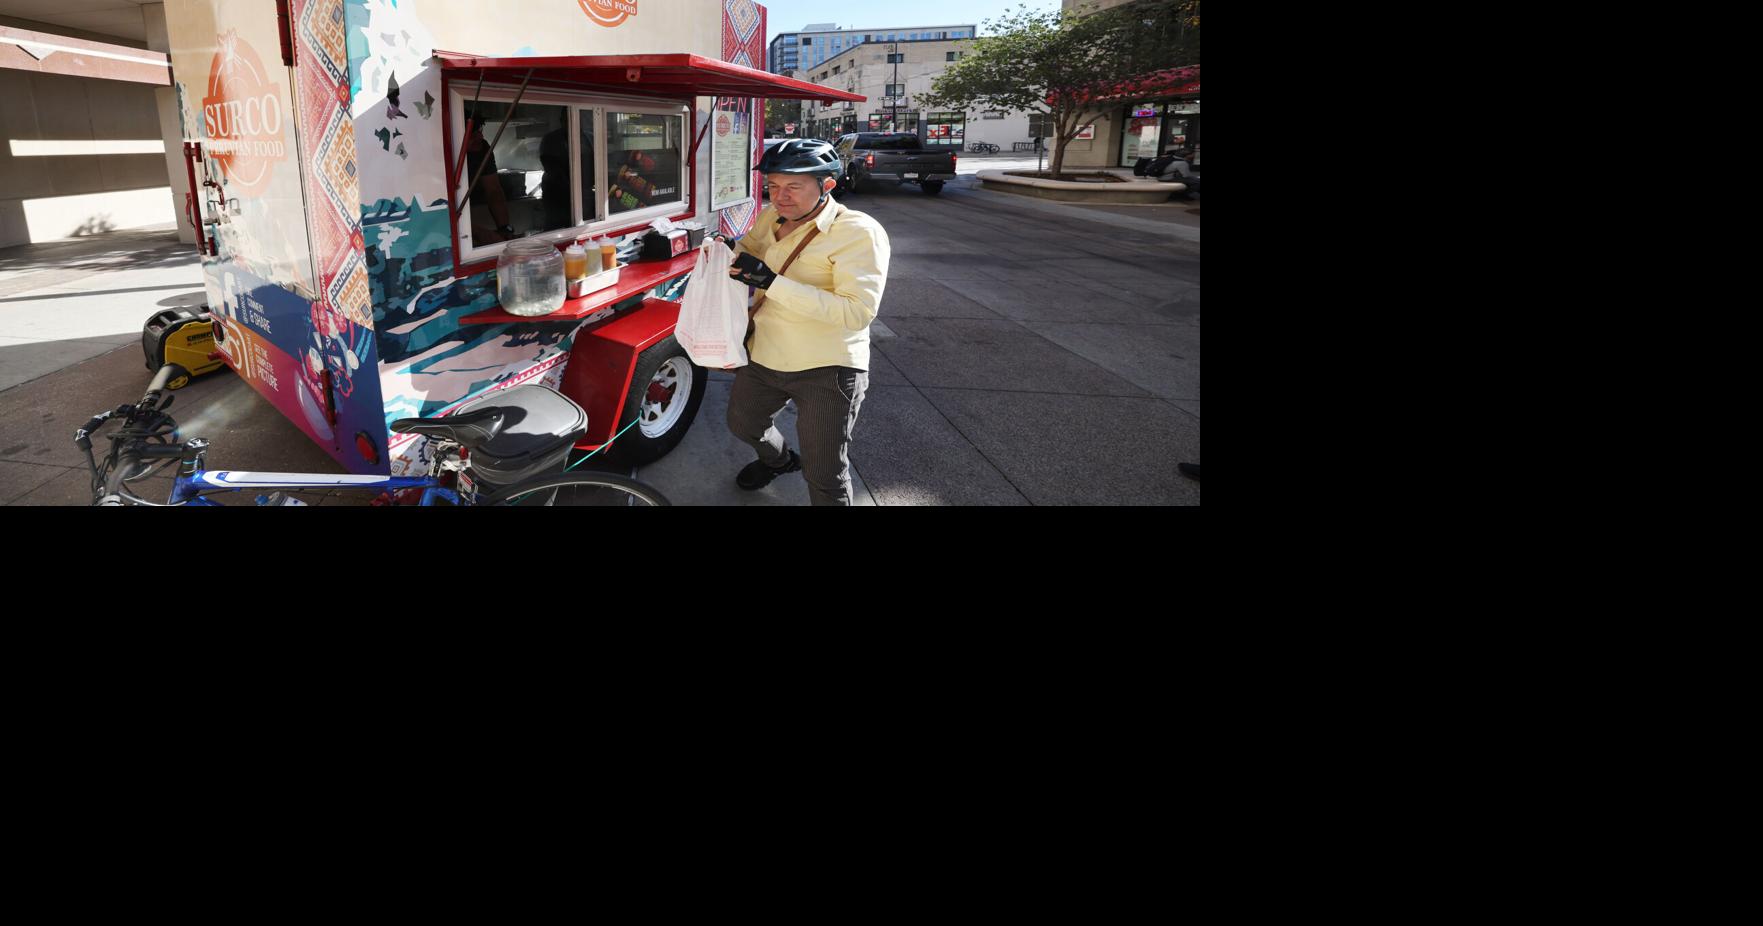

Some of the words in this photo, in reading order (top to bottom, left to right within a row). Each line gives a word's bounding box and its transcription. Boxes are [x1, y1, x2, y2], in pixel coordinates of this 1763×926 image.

[615, 1, 636, 14] FOOD
[205, 94, 281, 137] SURCO
[255, 140, 285, 157] FOOD
